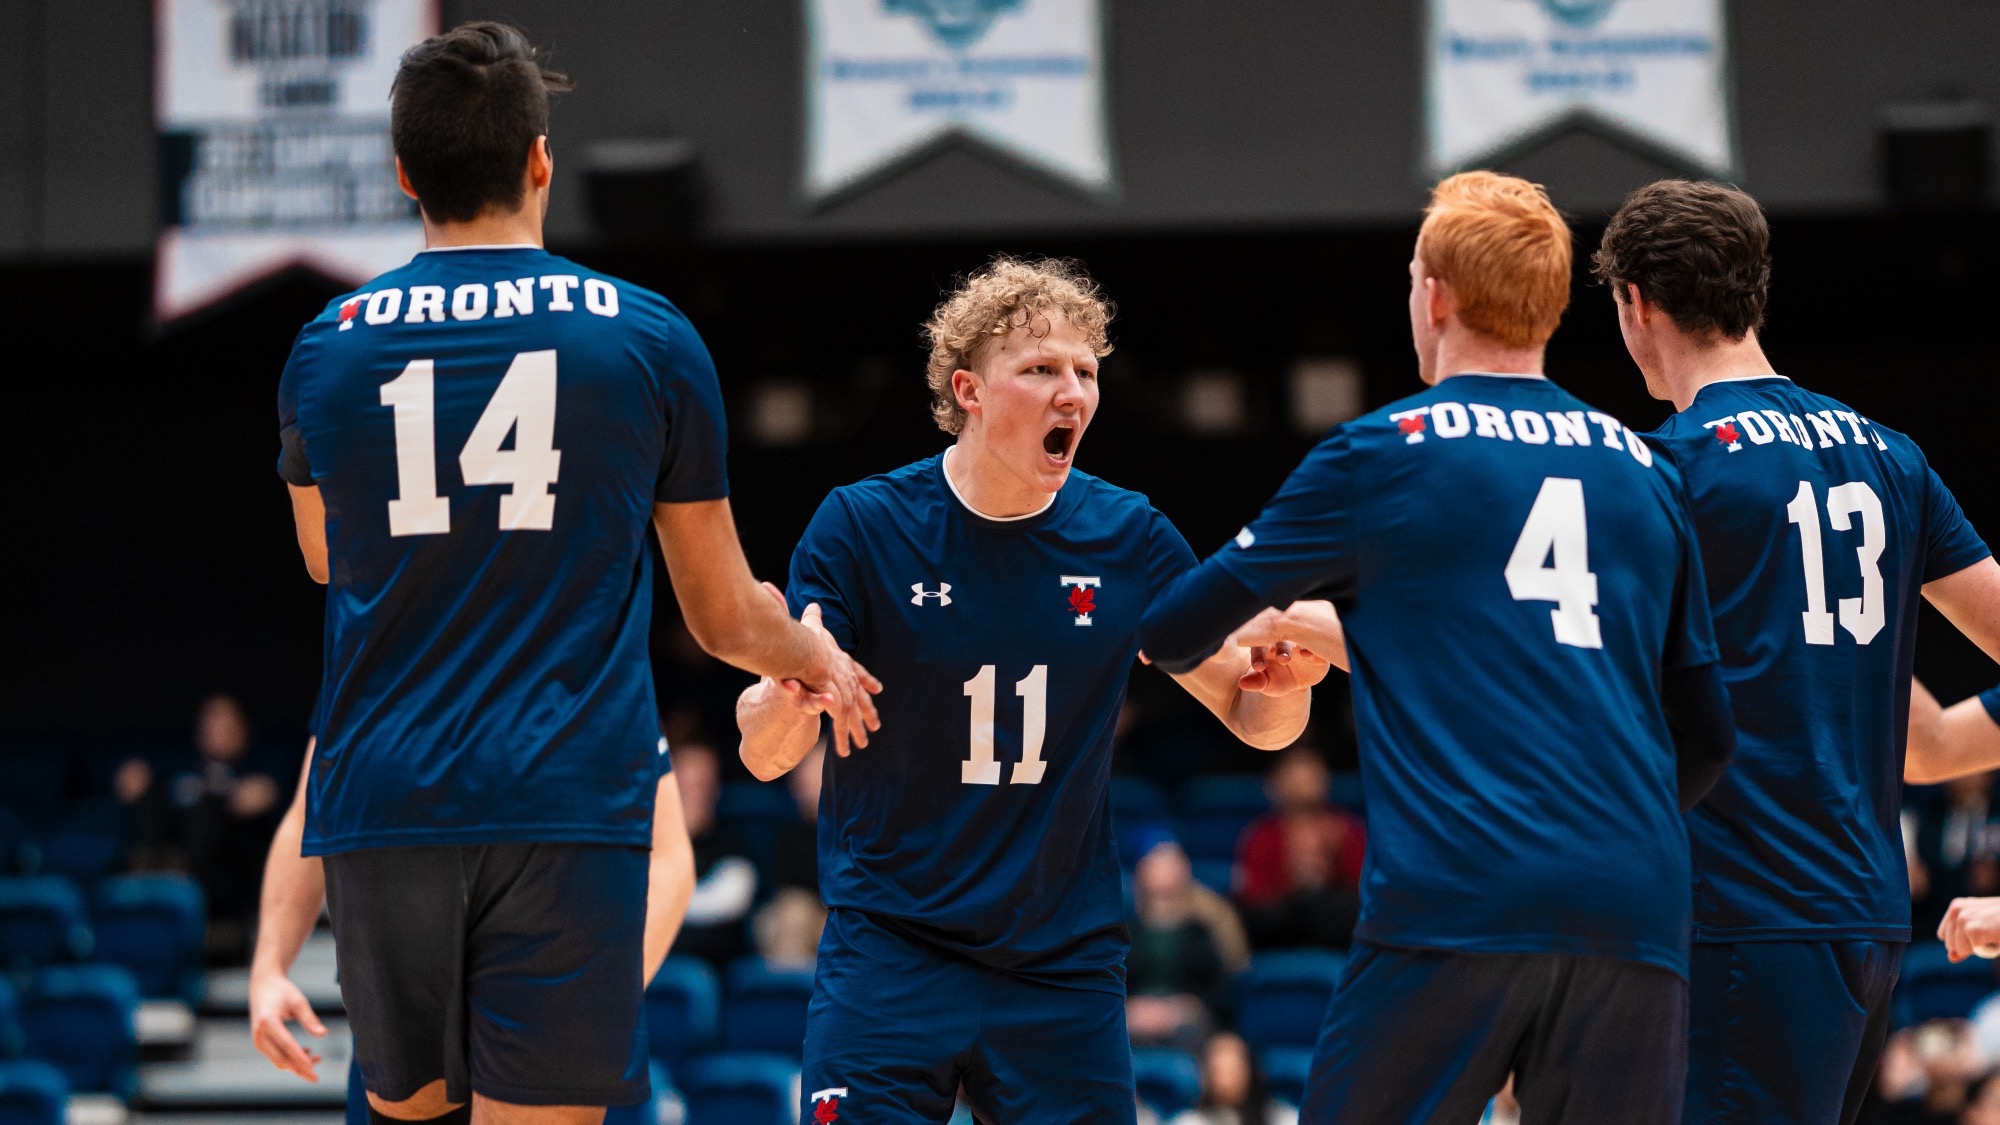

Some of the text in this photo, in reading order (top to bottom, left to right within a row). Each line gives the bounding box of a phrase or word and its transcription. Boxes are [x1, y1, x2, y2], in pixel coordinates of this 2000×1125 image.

[337, 274, 620, 332] TORONTO
[379, 349, 561, 537] 14
[1389, 402, 1653, 468] TORONTO
[1503, 476, 1603, 650] 4
[1786, 480, 1886, 645] 13
[961, 664, 1048, 786] 11
